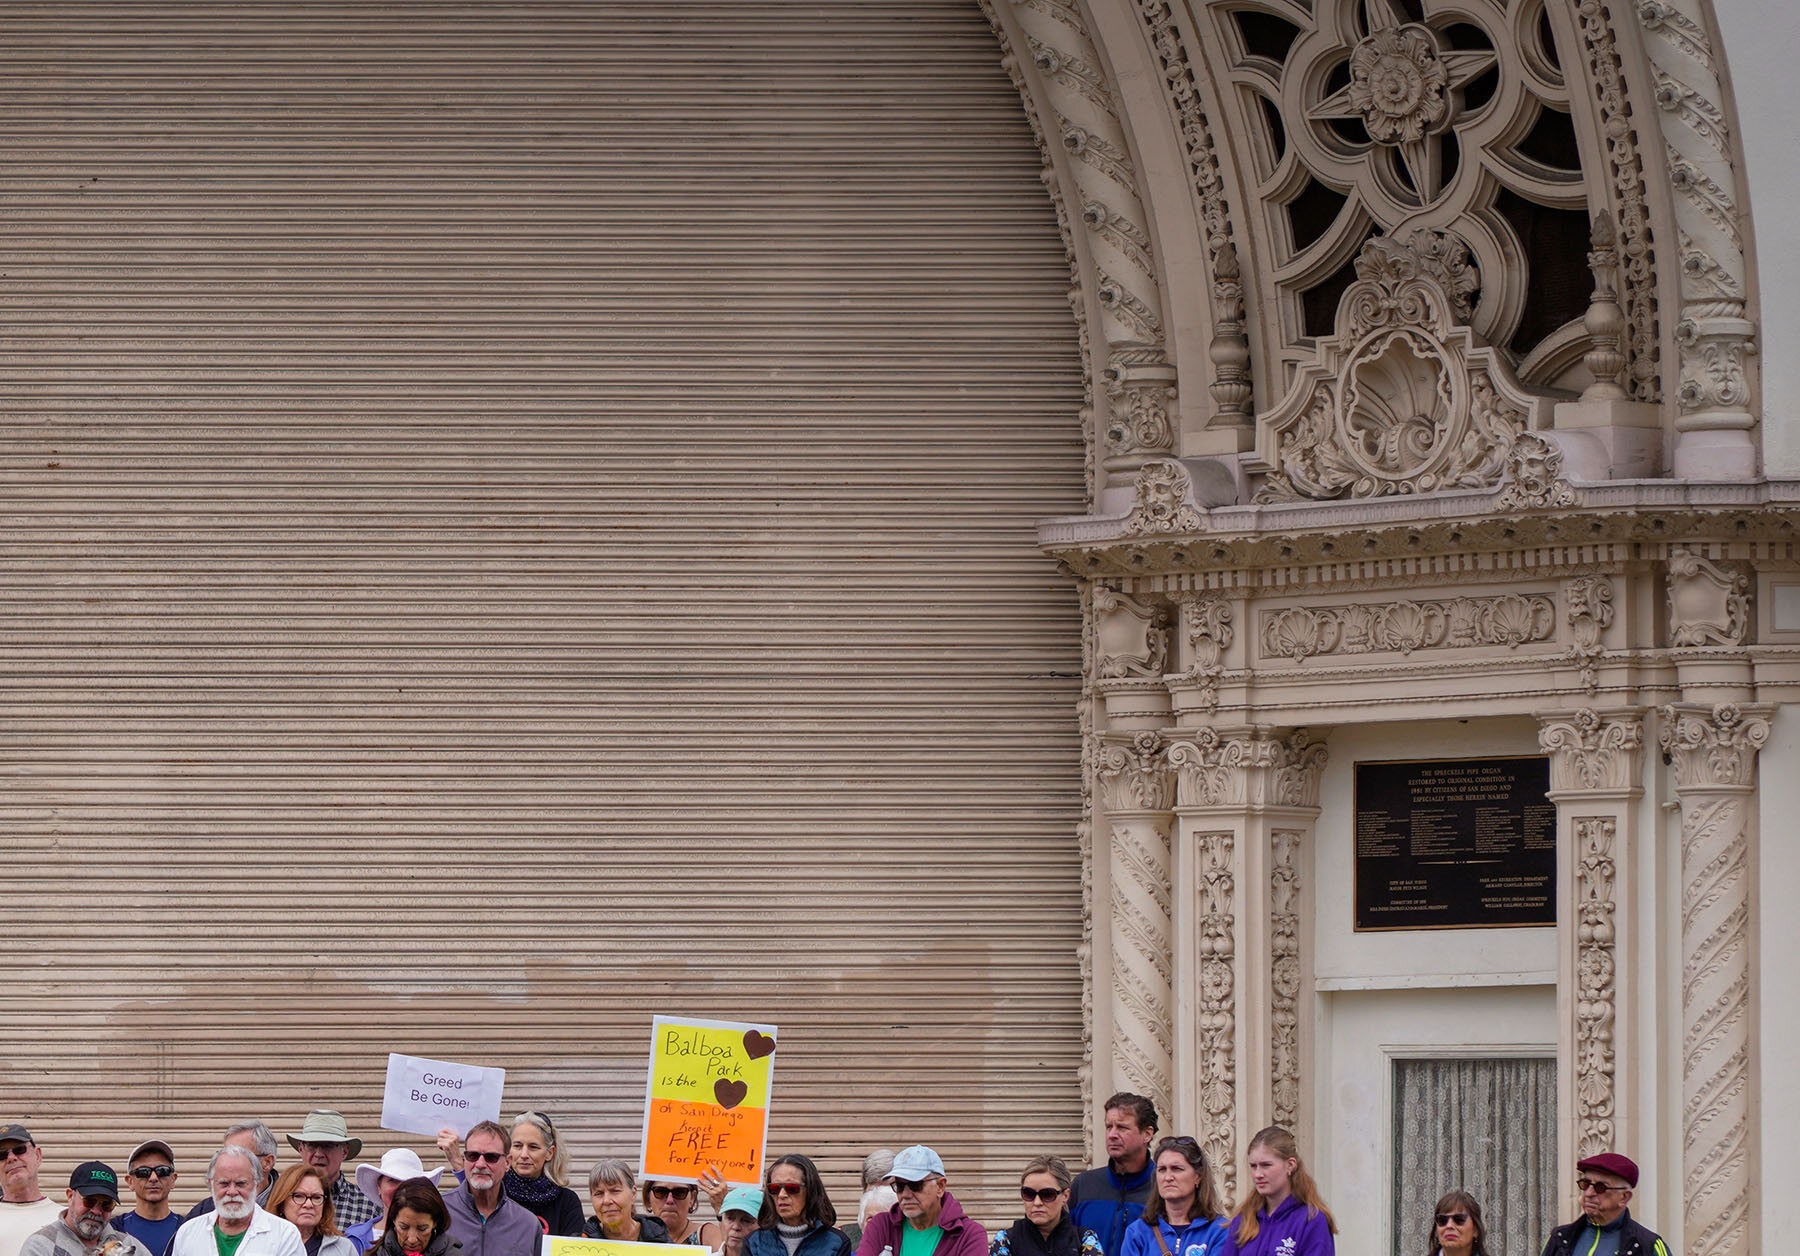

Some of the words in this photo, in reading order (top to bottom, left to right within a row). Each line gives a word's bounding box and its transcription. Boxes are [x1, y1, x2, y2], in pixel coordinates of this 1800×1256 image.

[666, 1031, 733, 1058] Balboa
[706, 1057, 743, 1077] Park
[423, 1073, 463, 1089] Greed
[675, 1073, 697, 1087] the
[410, 1089, 428, 1102] Be
[432, 1093, 470, 1109] Gone!
[659, 1102, 673, 1114] of
[680, 1104, 705, 1116] San
[711, 1108, 744, 1126] Diego
[668, 1132, 731, 1151] FREE
